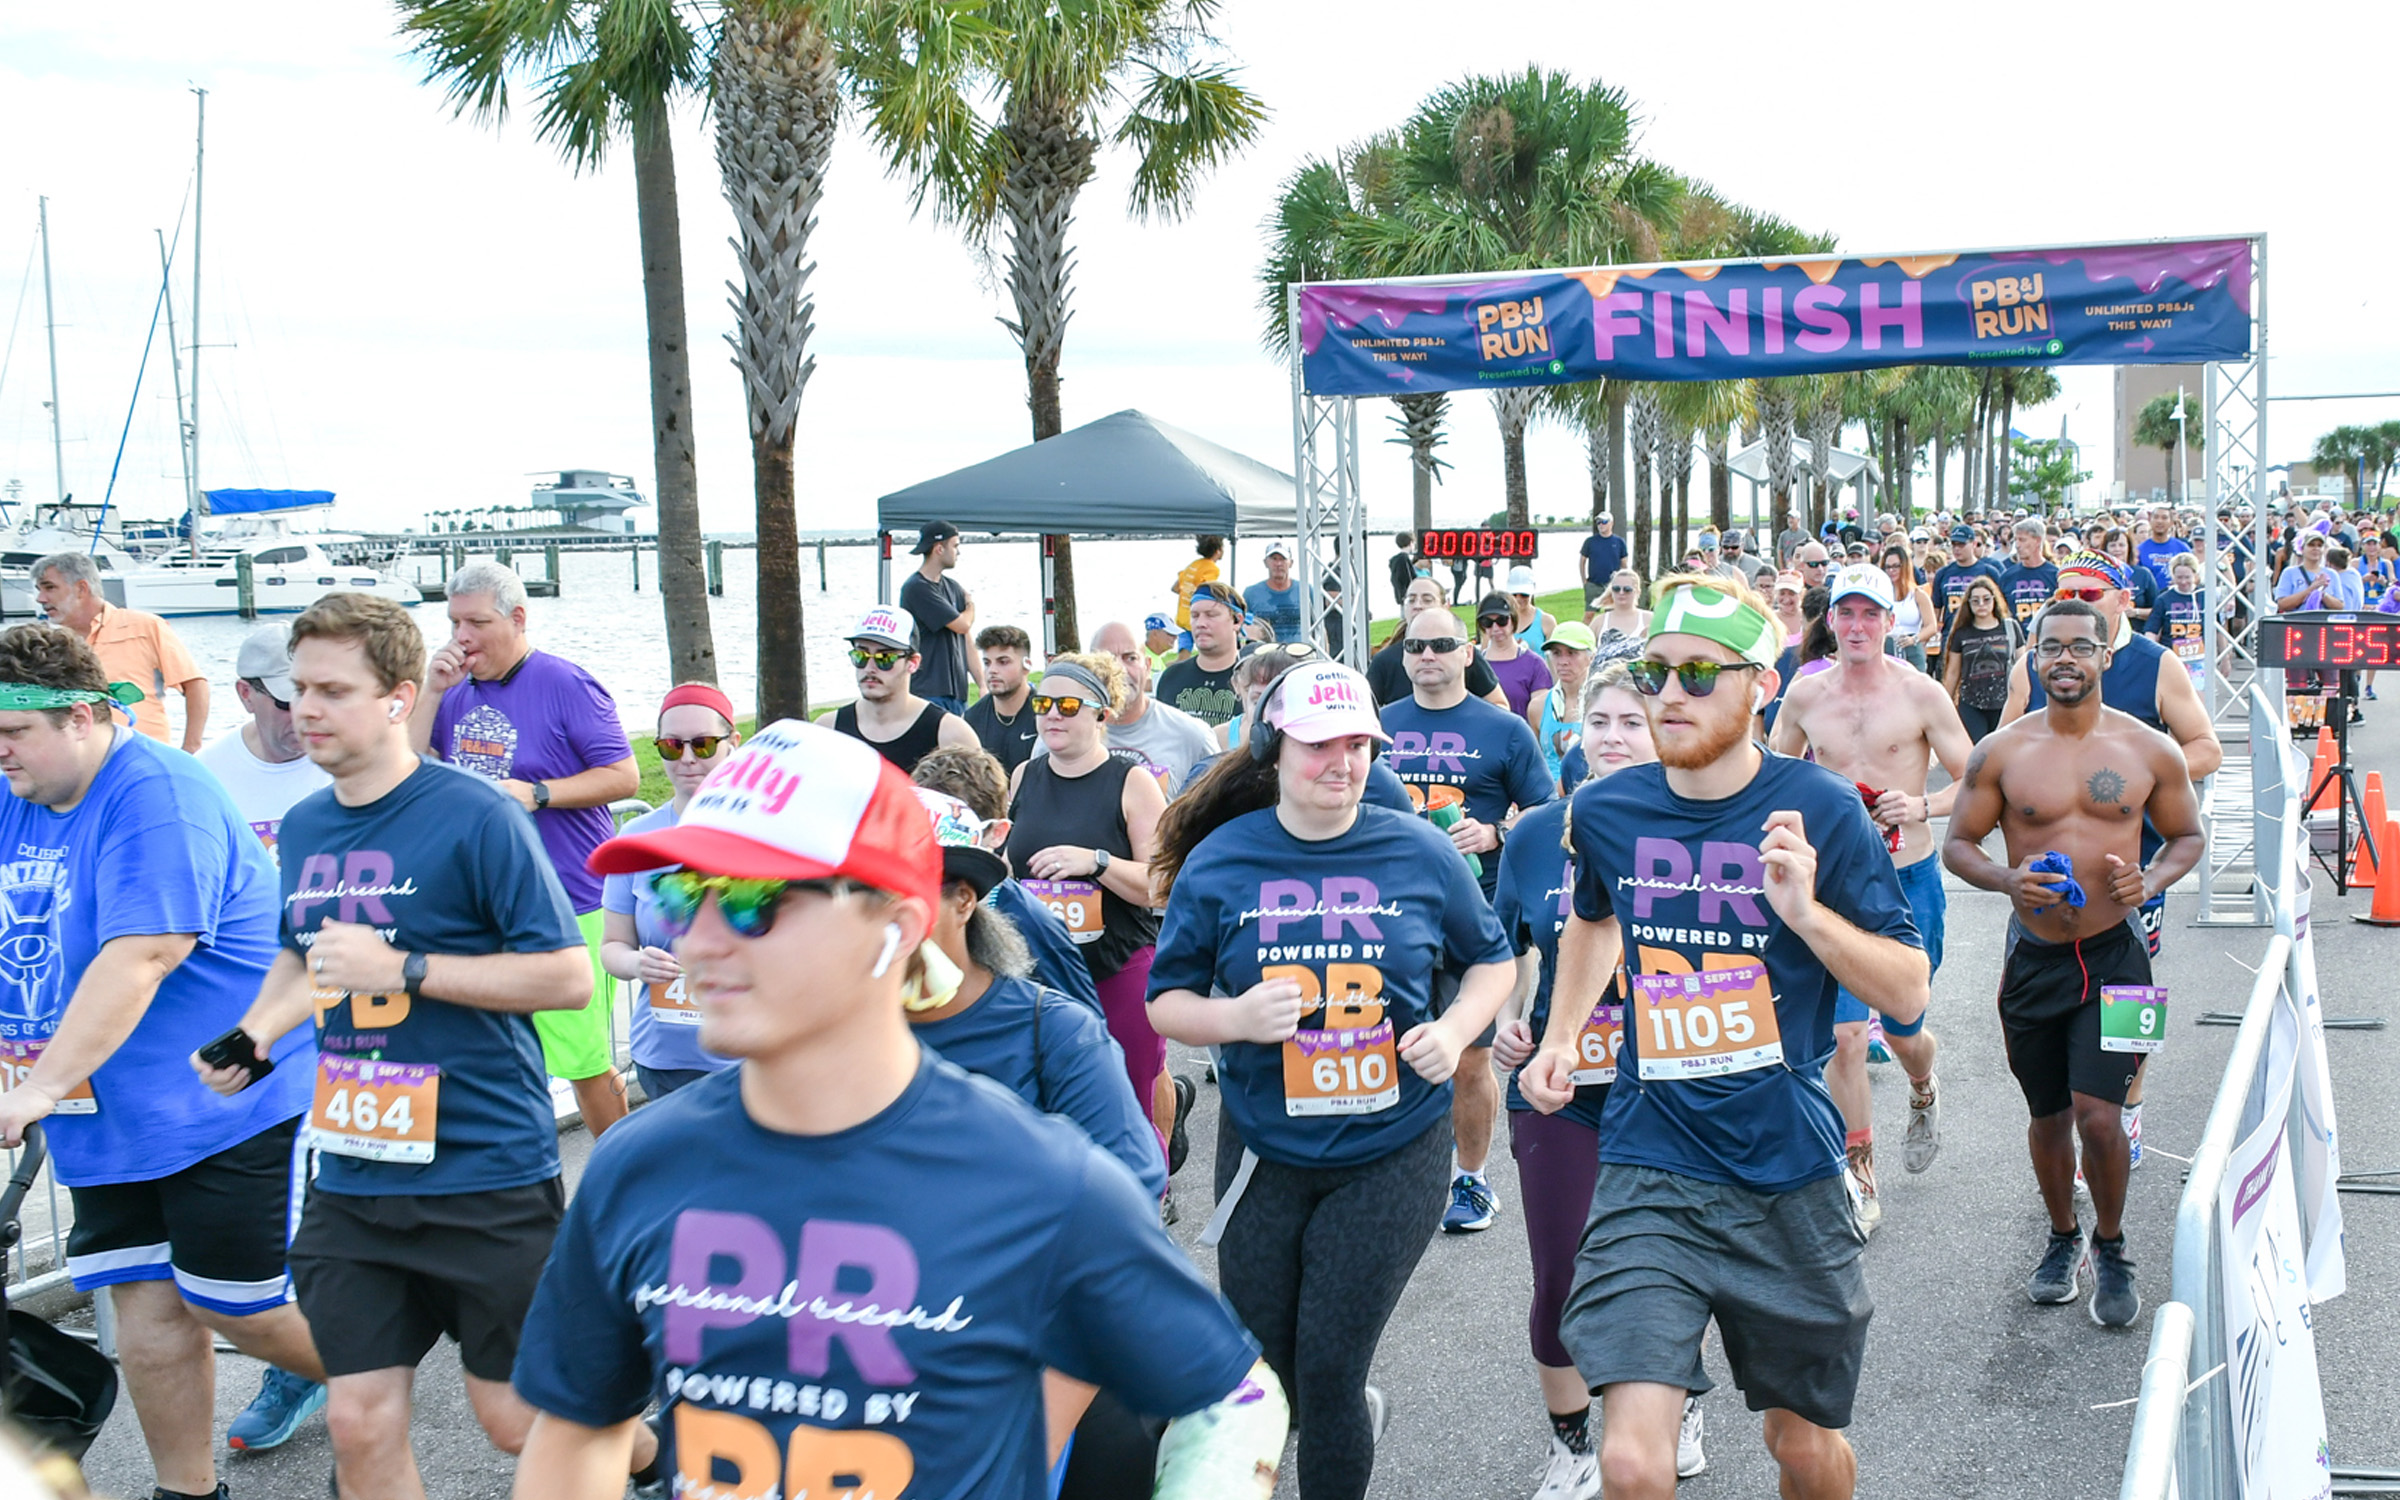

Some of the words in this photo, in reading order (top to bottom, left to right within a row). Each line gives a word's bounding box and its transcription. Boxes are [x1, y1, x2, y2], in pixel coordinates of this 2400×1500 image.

[1972, 273, 2044, 310] PB&J
[1477, 296, 1543, 333] PB&J
[1592, 279, 1925, 362] FINISH
[1975, 303, 2048, 339] RUN
[2085, 306, 2153, 316] UNLIMITED
[2108, 321, 2136, 331] THIS
[2140, 319, 2172, 329] WAY!
[1351, 338, 1410, 349] UNLIMITED
[1372, 352, 1397, 362] THIS
[1400, 352, 1427, 362] WAY!
[1481, 326, 1549, 361] RUN
[1968, 347, 2025, 360] Presented
[2027, 345, 2041, 357] by
[1478, 368, 1530, 380] Presented
[1532, 366, 1545, 377] by
[2015, 580, 2046, 598] PR
[2178, 644, 2199, 656] 837
[2284, 626, 2400, 665] 1:13:5
[1389, 732, 1466, 772] PR
[706, 751, 802, 815] elly
[1451, 774, 1467, 784] BY
[292, 849, 395, 928] PR
[1618, 874, 1707, 893] personal
[1710, 881, 1765, 895] reco
[1633, 836, 1769, 927] PR
[1042, 901, 1085, 928] 69
[1239, 900, 1329, 927] personal
[1331, 901, 1403, 917] record
[1259, 876, 1385, 942] PR
[1631, 924, 1732, 946] POWERED
[1741, 933, 1769, 949] BY
[1257, 944, 1354, 962] POWERED
[1362, 944, 1385, 961] BY
[1704, 973, 1732, 985] SEPT
[1735, 970, 1753, 981] '22
[1648, 1001, 1756, 1051] 1105
[2139, 1007, 2156, 1035] 9
[1358, 1029, 1383, 1041] SEPT
[1312, 1053, 1388, 1092] 610
[1681, 1058, 1706, 1068] PB&J
[1709, 1055, 1734, 1065] RUN
[325, 1087, 414, 1136] 464
[1357, 1098, 1377, 1106] RUN
[634, 1280, 807, 1319] personal
[808, 1295, 974, 1333] record
[664, 1207, 920, 1387] PR
[665, 1366, 849, 1421] POWERED
[863, 1390, 921, 1425] BY
